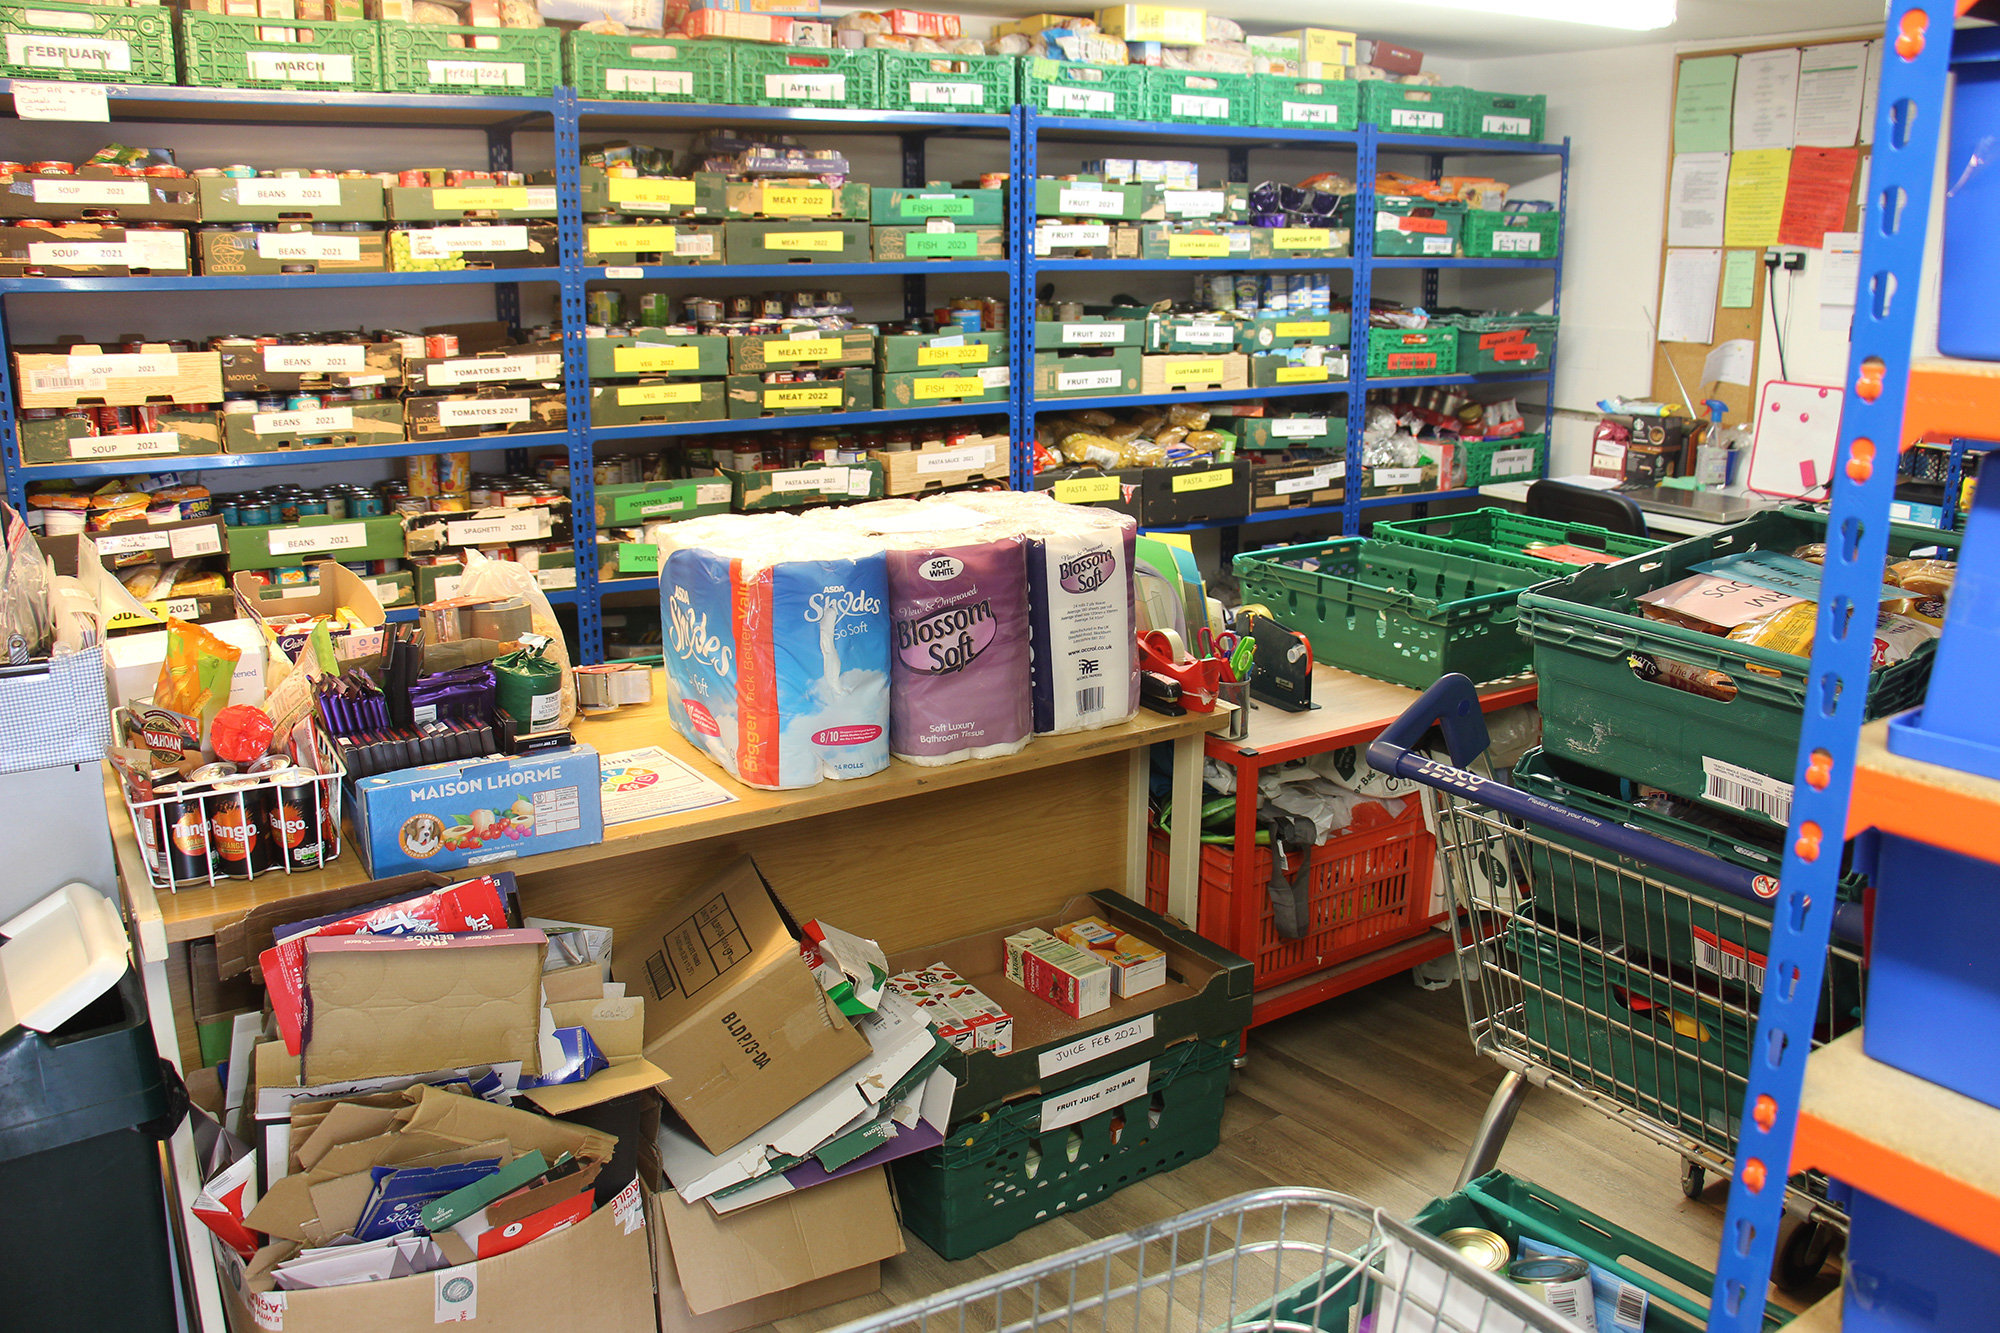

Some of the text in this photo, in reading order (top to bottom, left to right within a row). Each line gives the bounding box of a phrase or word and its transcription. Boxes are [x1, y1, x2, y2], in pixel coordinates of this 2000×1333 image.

[27, 45, 112, 61] FEBRUARY
[276, 61, 325, 72] MARCH
[790, 83, 822, 93] APRIL
[936, 86, 958, 94] MAY
[1072, 93, 1092, 102] MAY
[58, 186, 126, 196] SOUP 2021
[257, 189, 323, 199] BEANS 2021
[772, 196, 824, 206] MEAT 2022
[1068, 200, 1116, 209] FRUIT 2021
[913, 204, 964, 214] FISH 2023
[1051, 231, 1101, 240] FRUIT 2021
[446, 240, 484, 248] TOMATOES
[781, 239, 830, 247] MEAT 2022
[917, 241, 968, 251] FISH 2023
[51, 248, 124, 259] SOUP 2021
[278, 248, 343, 256] BEANS 2021
[1071, 330, 1116, 339] FRUIT 2021
[1185, 331, 1209, 339] CUSTARD
[778, 347, 830, 358] MEAT 2022
[929, 349, 979, 359] FISH 2022
[283, 358, 347, 368] BEANS 2021
[640, 360, 676, 368] VEG 2022
[91, 365, 157, 376] SOUP 2021
[454, 365, 523, 378] TOMATOES 2021
[1175, 368, 1202, 377] CUSTARD
[228, 374, 259, 383] MOYCA
[1066, 376, 1114, 387] FRUIT 2021
[925, 384, 975, 394] FISH 2022
[778, 392, 830, 402] MEAT 2022
[451, 407, 520, 418] TOMATOES 2021
[272, 416, 336, 429] BEANS 2021
[91, 441, 159, 456] SOUP 2021
[928, 456, 976, 468] PASTA SAUCE 2021
[1496, 456, 1517, 465] COFFEE
[784, 477, 837, 488] PASTA SAUCE 2021
[1183, 474, 1224, 488] PASTA 2022
[1066, 483, 1110, 495] PASTA 2022
[190, 500, 210, 512] BIG
[629, 498, 662, 508] POTATOES
[463, 524, 528, 537] SPAGHETTI 2021
[287, 536, 351, 550] BEANS 2021
[930, 559, 952, 571] SOFT
[1060, 548, 1114, 582] Blossom
[929, 567, 956, 579] WHITE
[1077, 566, 1104, 592] Soft
[674, 585, 690, 605] ASDA
[822, 585, 846, 594] ASDA
[899, 583, 979, 621] New & Improved
[168, 603, 197, 615] 2021
[846, 620, 869, 636] Soft
[896, 598, 992, 651] Blossom
[928, 632, 975, 674] Soft
[1670, 663, 1688, 679] The
[741, 628, 761, 773] Bigger Better
[184, 719, 198, 741] New!
[929, 720, 977, 736] Soft Luxury
[143, 730, 184, 755] IDAHOAN
[819, 730, 840, 744] 8/10
[919, 729, 986, 747] Bathroom Tissue
[842, 762, 865, 771] ROLLS
[1422, 757, 1488, 786] TESCO
[411, 765, 563, 803] MAISON LHORME
[1361, 770, 1376, 787] Bag
[1526, 796, 1602, 828] Please return your trolley
[406, 932, 456, 943] BENTOS
[416, 938, 450, 948] FRAY
[1030, 954, 1038, 993] Cranberry
[1055, 1025, 1144, 1064] JUICE FEB 2021
[1057, 1077, 1138, 1113] FRUIT JUICE 2021 MAR
[508, 1223, 518, 1235] 4
